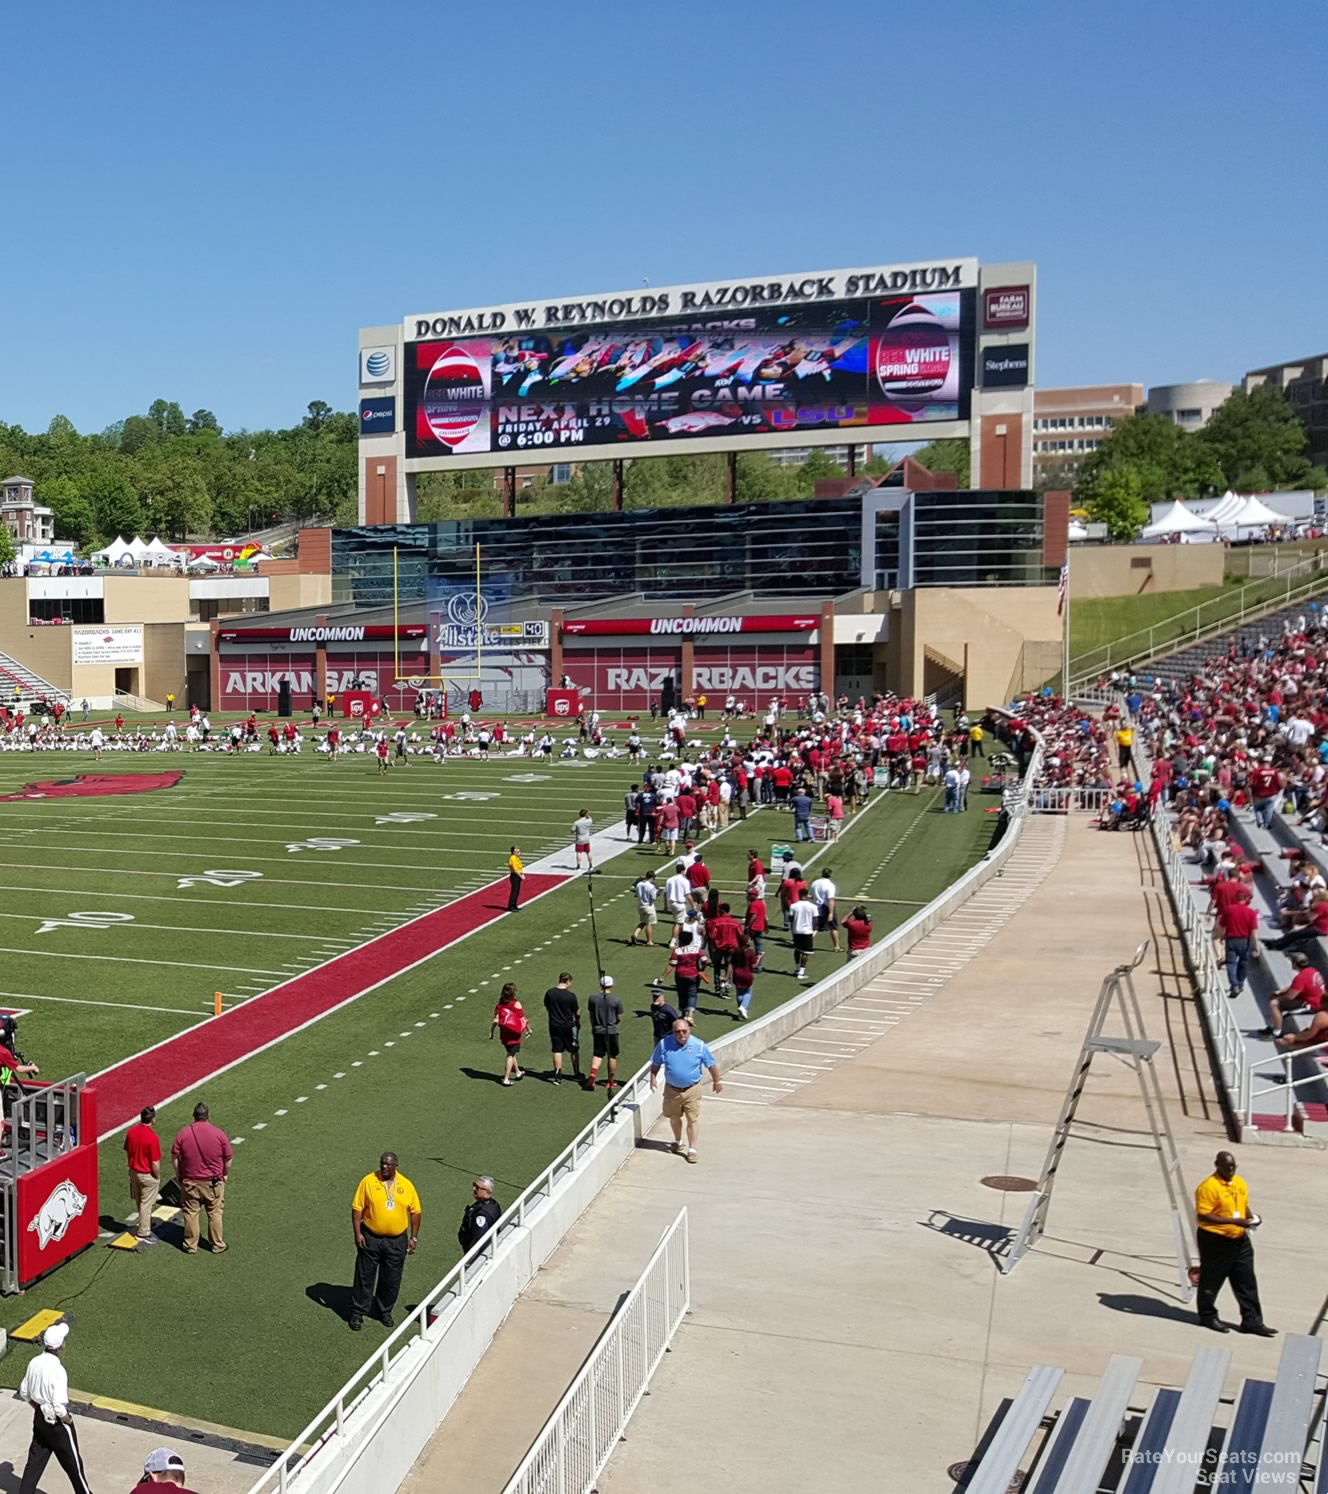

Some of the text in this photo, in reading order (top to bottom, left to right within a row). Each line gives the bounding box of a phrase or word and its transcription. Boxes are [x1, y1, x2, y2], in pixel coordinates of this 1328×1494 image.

[415, 265, 962, 338] DONALD W. REYNOLDS RAZORBACK STADIUM
[990, 302, 1024, 312] BUREAU
[905, 346, 950, 363] WHITE
[879, 363, 918, 377] SPRING
[985, 359, 1027, 372] Stephens
[448, 385, 484, 401] WHITE
[498, 383, 785, 423] NEXT HOME GAME
[372, 409, 393, 420] pepsi
[772, 405, 855, 425] LSU
[498, 416, 611, 434] FRIDAY, APRIL 29
[517, 430, 554, 446] 6:00
[560, 428, 584, 443] PM
[289, 626, 365, 642] UNCOMMON
[526, 623, 542, 635] 40
[650, 617, 743, 635] UNCOMMON
[436, 625, 500, 646] Allstate
[225, 671, 378, 693] ARKANSAS
[351, 703, 363, 716] ups
[556, 703, 569, 713] ups
[177, 869, 264, 889] 20
[34, 911, 136, 934] 10
